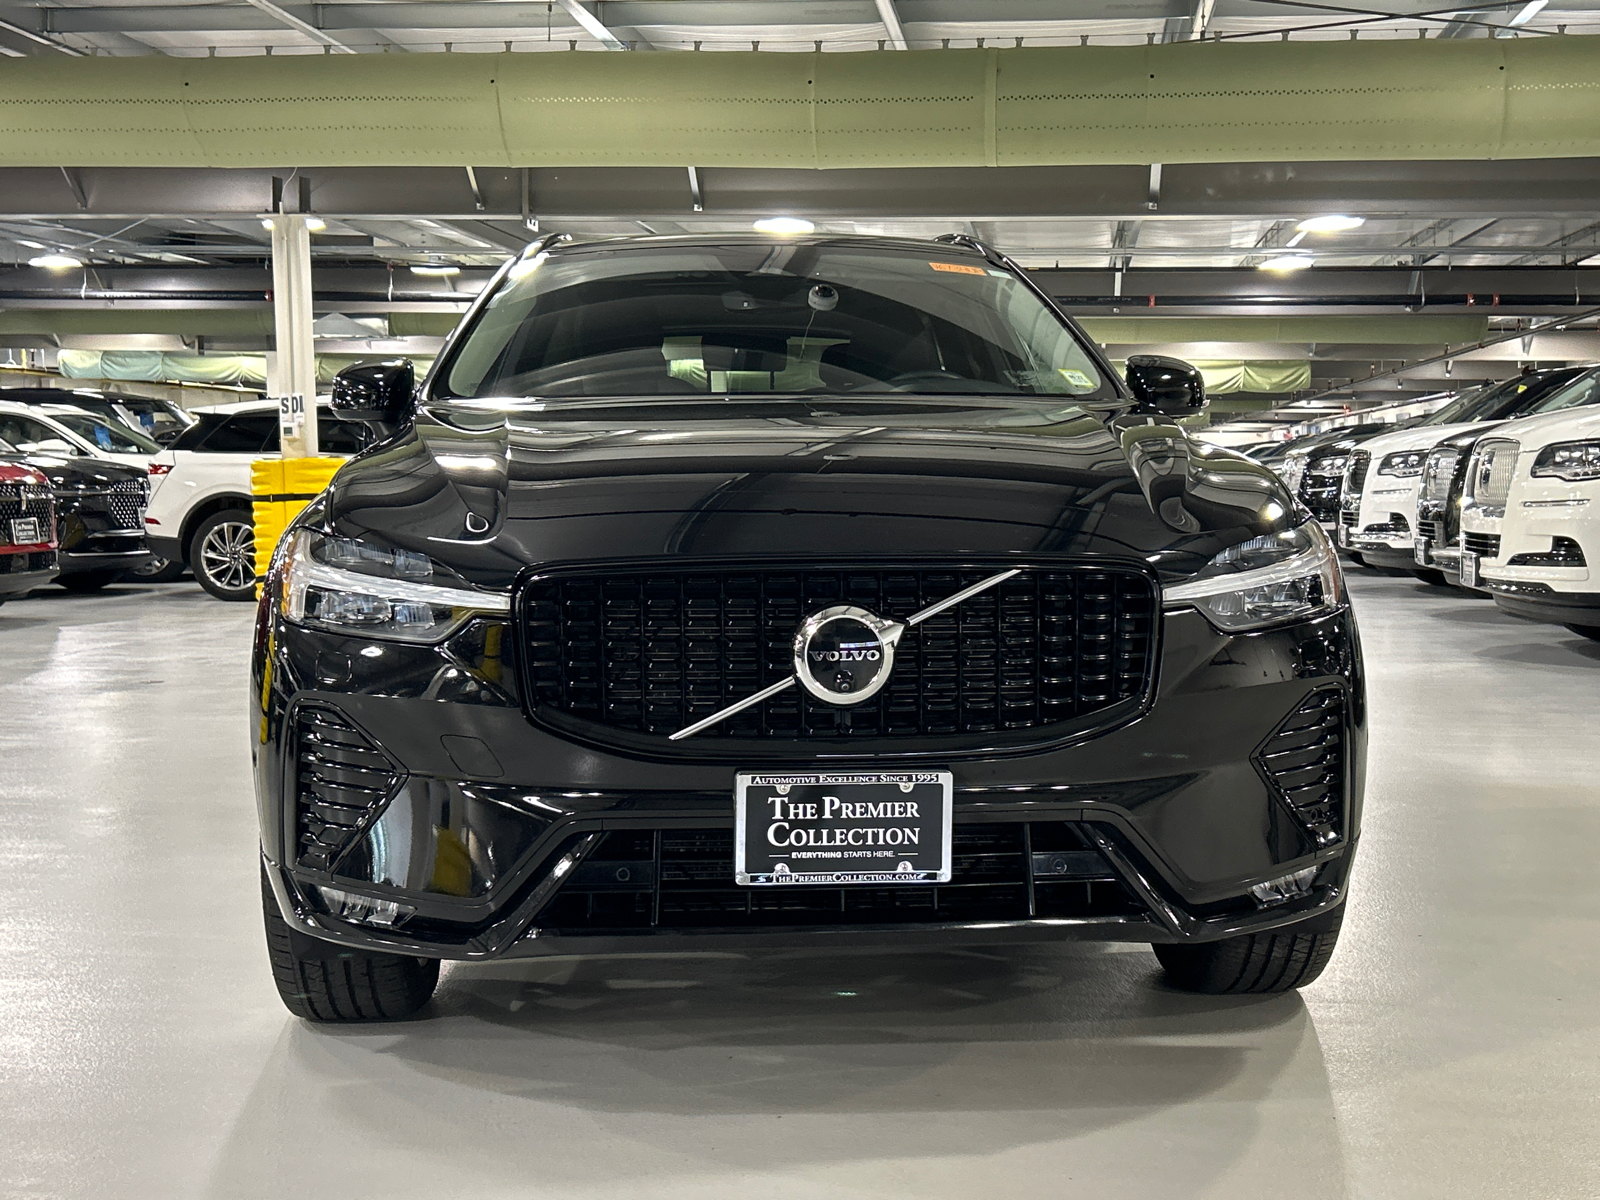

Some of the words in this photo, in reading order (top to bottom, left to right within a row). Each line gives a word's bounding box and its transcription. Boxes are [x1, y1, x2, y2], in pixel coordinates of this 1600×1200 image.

[809, 650, 880, 662] VOLVO
[912, 774, 938, 783] 1995
[791, 851, 841, 859] EVERYTHING
